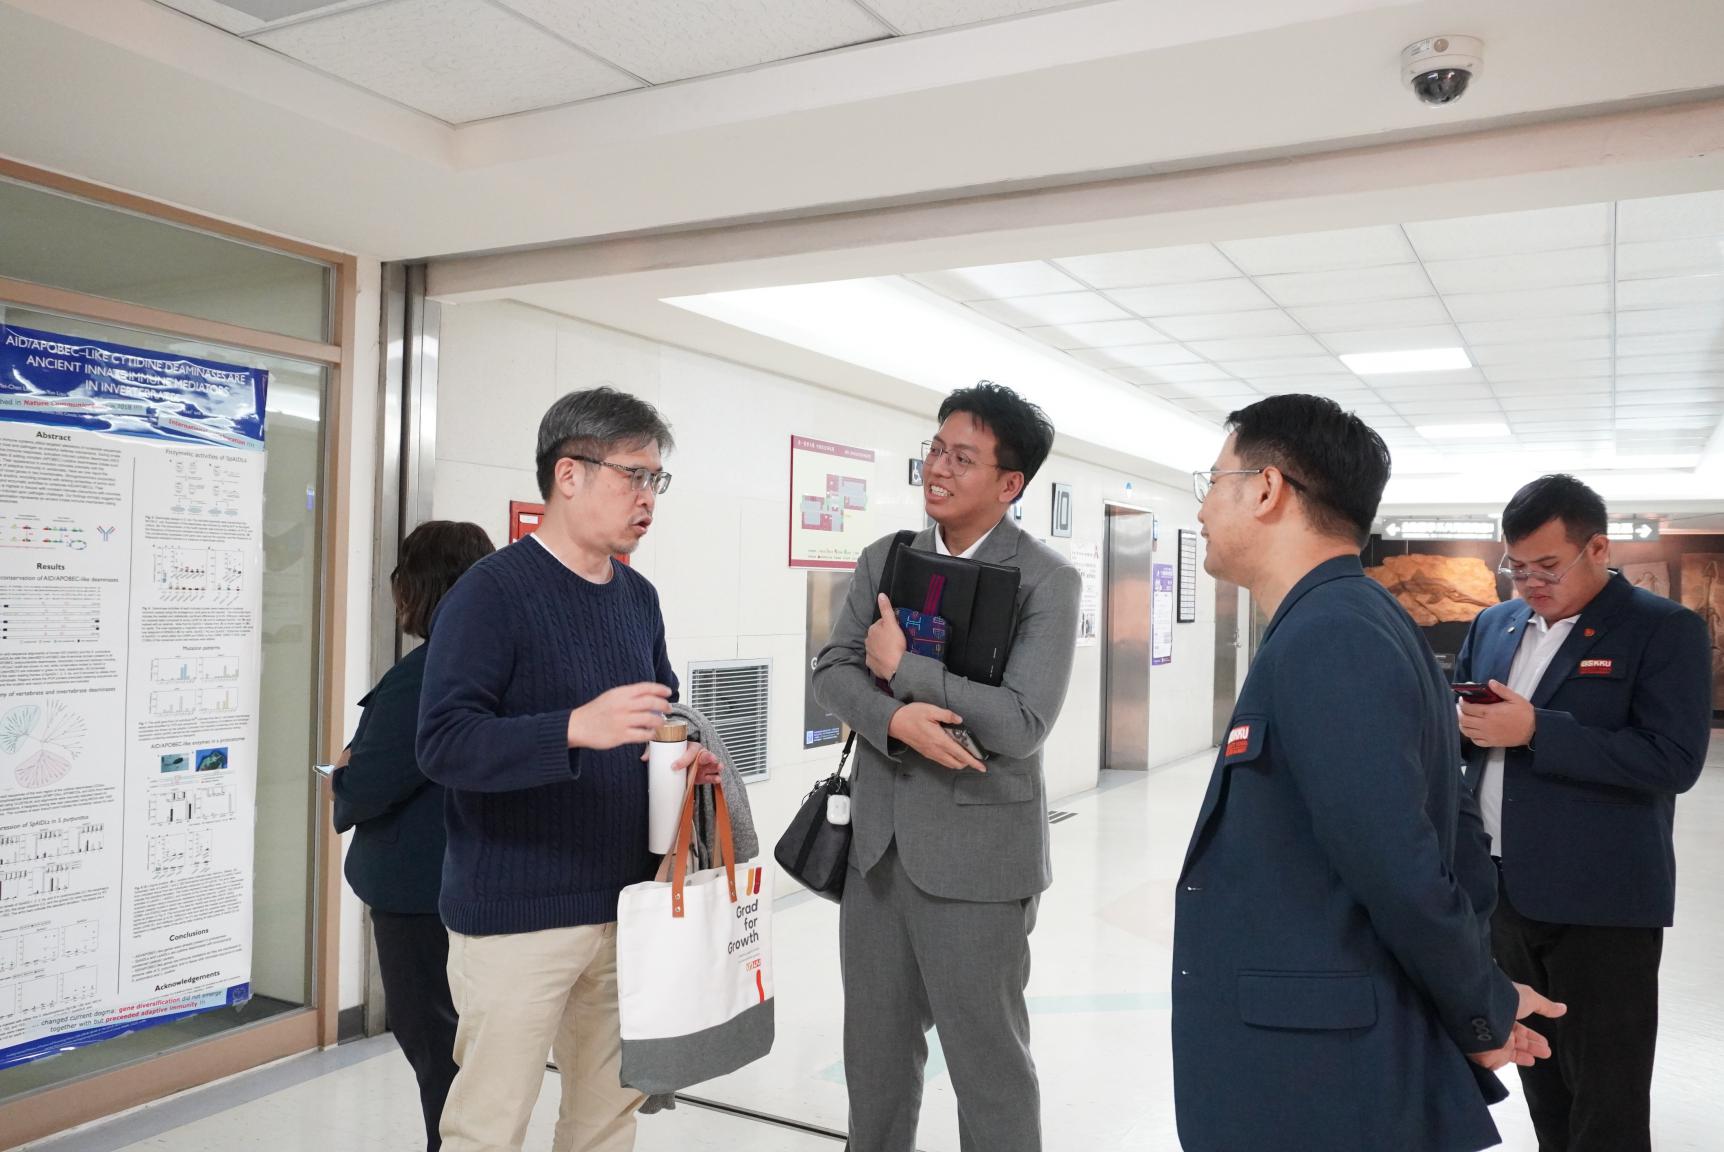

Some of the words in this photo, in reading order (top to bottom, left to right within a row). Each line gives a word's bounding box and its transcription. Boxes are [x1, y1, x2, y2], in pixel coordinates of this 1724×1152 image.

[26, 355, 82, 372] ANCIENT
[111, 353, 163, 371] CYTIDINE
[227, 373, 246, 384] ARE
[85, 380, 98, 391] IN
[23, 399, 49, 407] Nature
[36, 431, 72, 442] Abstract
[36, 562, 66, 571] Results
[736, 899, 759, 919] Grad
[744, 916, 759, 931] for
[168, 928, 209, 941] Conclusions
[727, 930, 760, 955] Growth
[154, 970, 221, 992] Acknowledgements
[41, 1015, 69, 1027] changed
[69, 1012, 93, 1022] current
[118, 1003, 135, 1013] gene
[136, 996, 181, 1010] diversification
[181, 994, 191, 1002] did
[50, 1022, 78, 1033] together
[79, 1019, 92, 1027] with
[93, 1017, 104, 1025] but
[140, 1006, 168, 1018] adaptive
[169, 1001, 198, 1013] immunity
